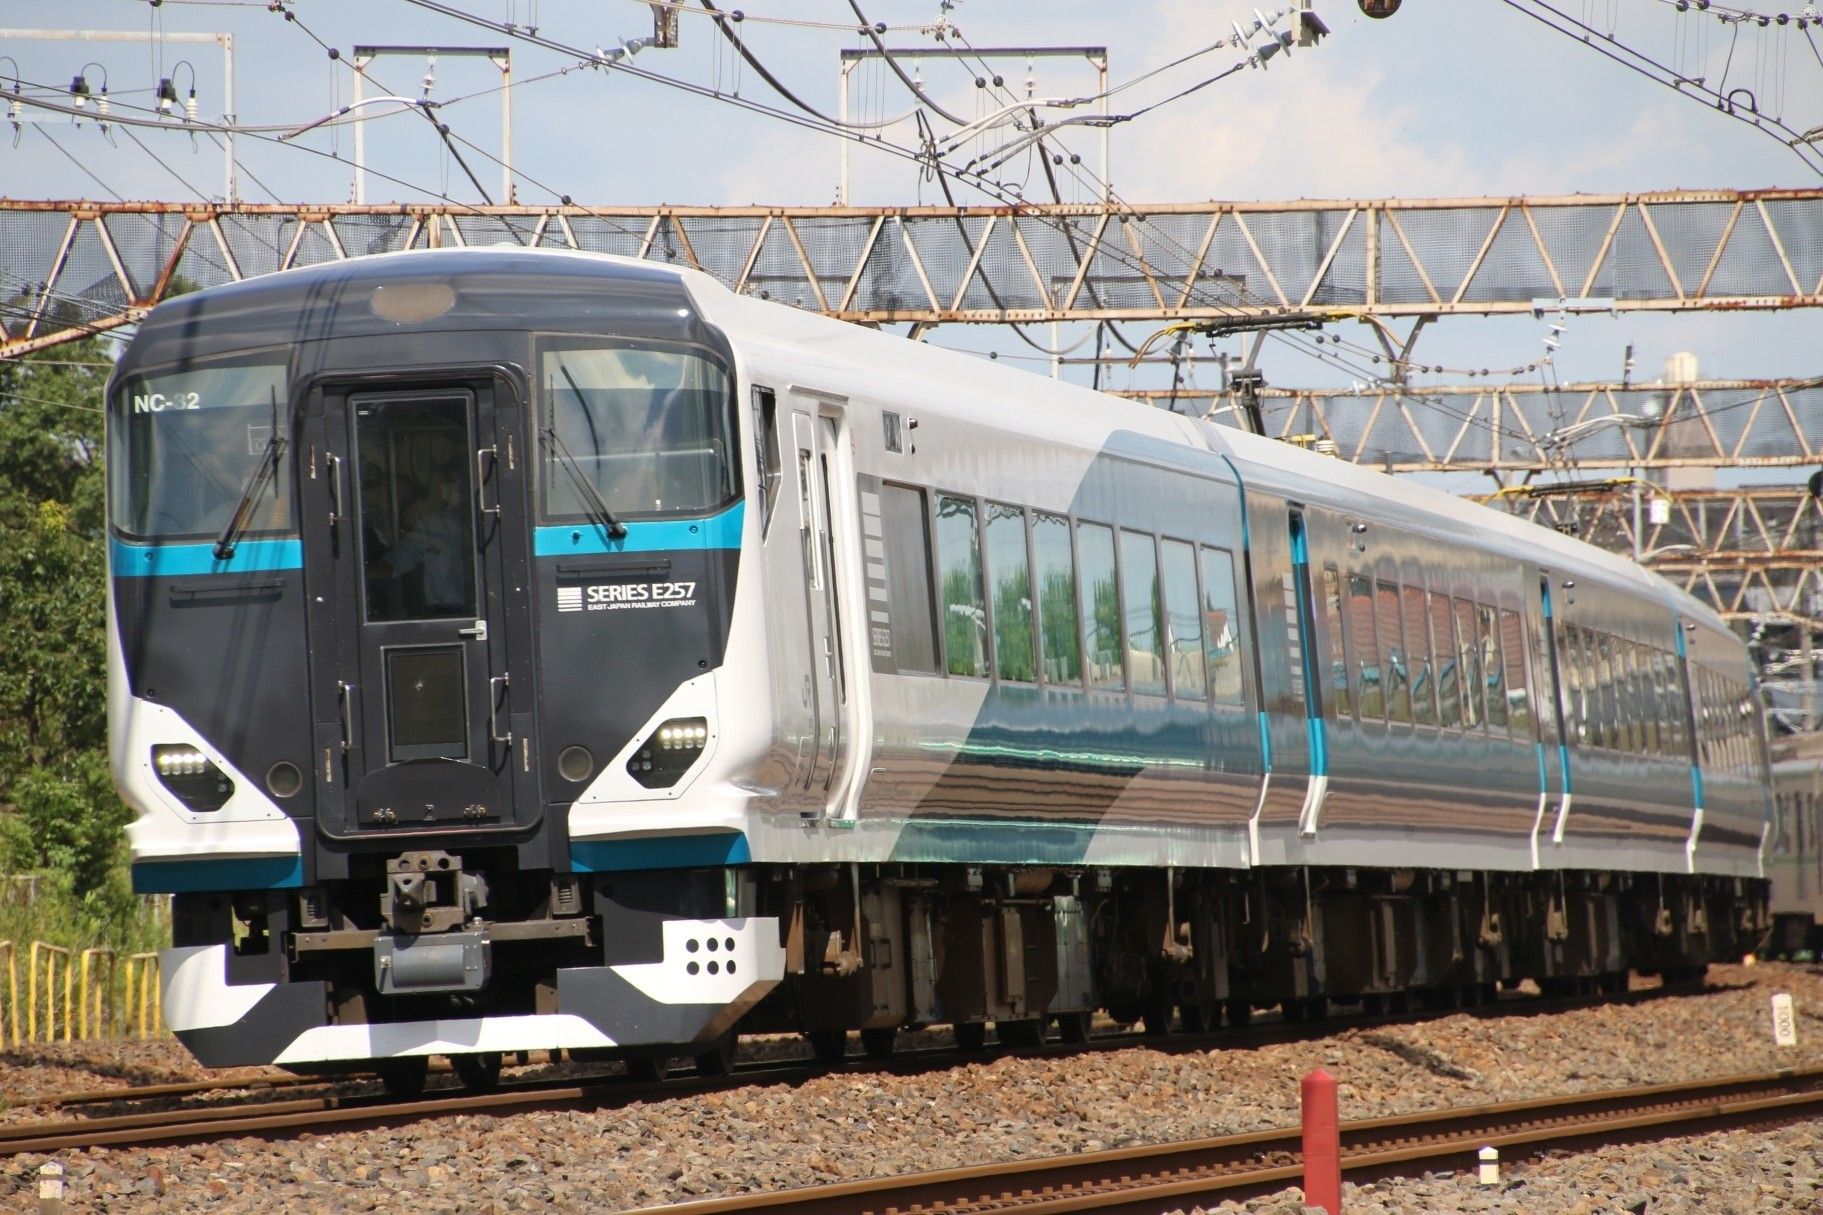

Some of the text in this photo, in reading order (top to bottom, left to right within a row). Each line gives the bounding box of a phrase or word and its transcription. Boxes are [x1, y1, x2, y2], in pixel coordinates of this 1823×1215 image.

[134, 392, 200, 413] NC-32
[587, 581, 696, 602] SERIES E257
[607, 602, 631, 610] JAPAN
[631, 601, 661, 609] RAILWAY
[661, 599, 697, 608] COMPANY
